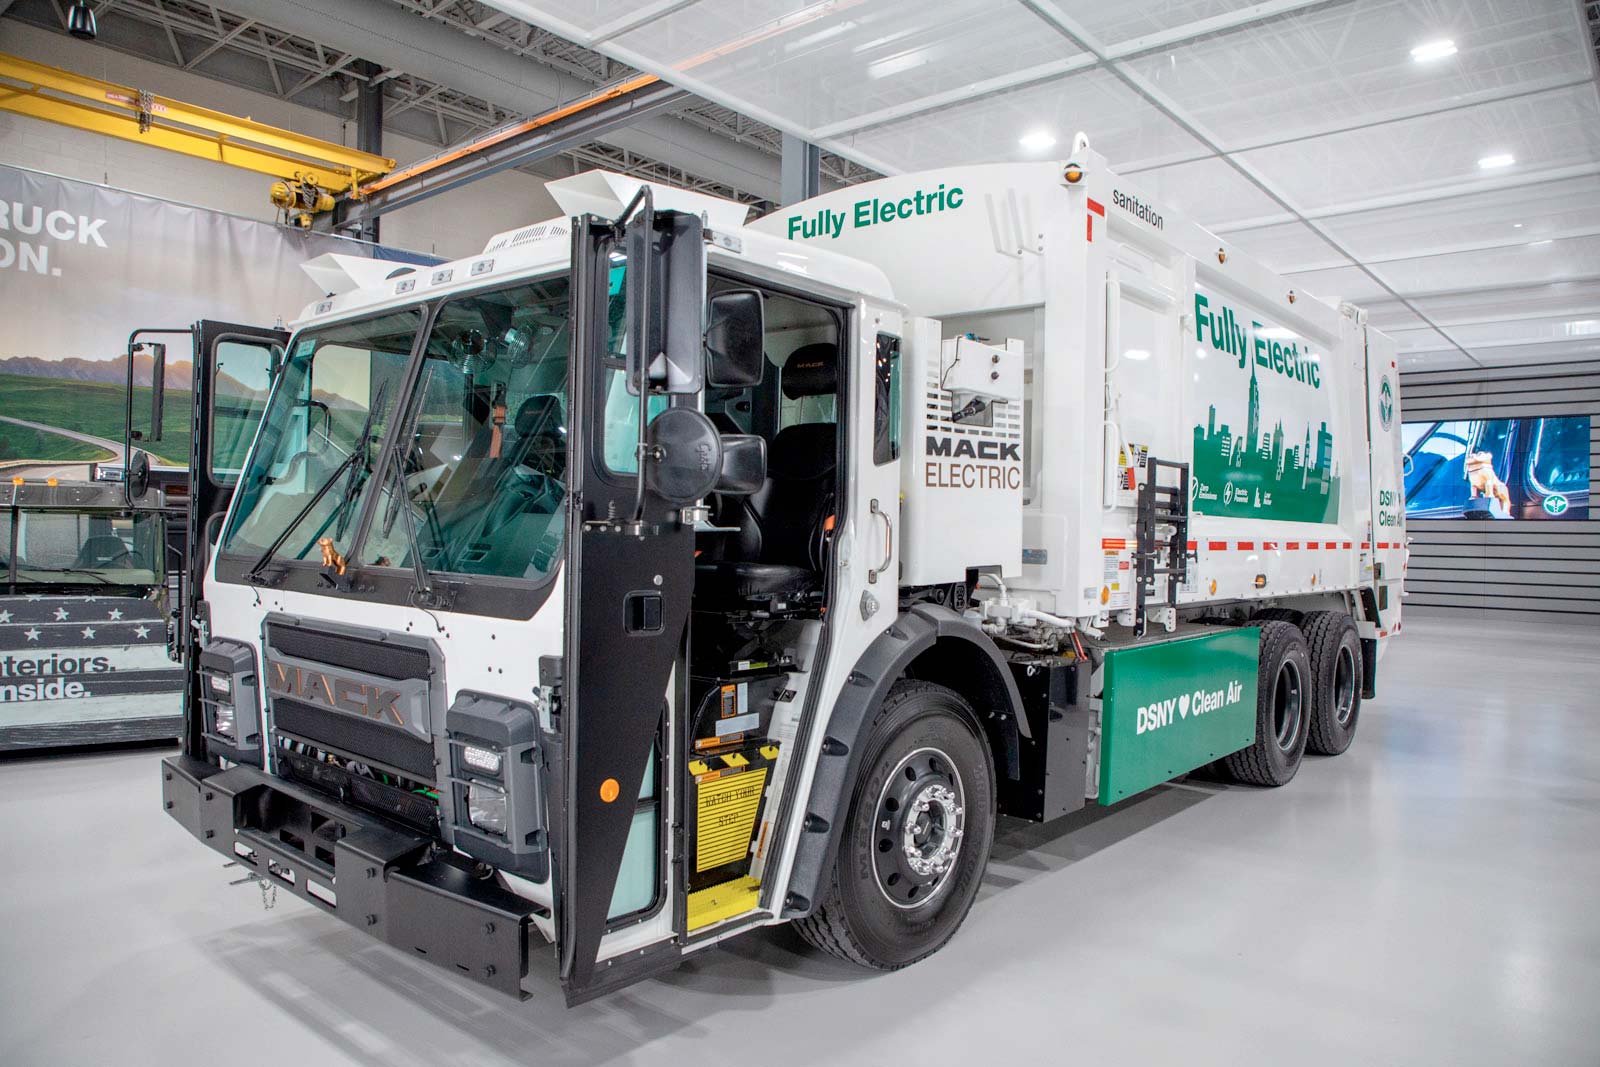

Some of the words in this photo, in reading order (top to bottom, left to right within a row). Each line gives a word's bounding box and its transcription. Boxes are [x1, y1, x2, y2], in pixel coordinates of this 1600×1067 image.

[788, 209, 846, 240] Fully
[854, 183, 964, 228] Electric
[1113, 189, 1163, 231] sanitation
[1195, 293, 1247, 369] Fully
[1252, 320, 1320, 389] Electric
[926, 436, 1020, 461] MACK
[925, 462, 1020, 490] ELECTRIC
[1379, 510, 1396, 527] Clean
[0, 653, 116, 677] teriors.
[268, 661, 404, 725] MACK
[1136, 697, 1177, 735] DSNY
[1192, 690, 1224, 716] Clean
[1226, 680, 1243, 706] Air
